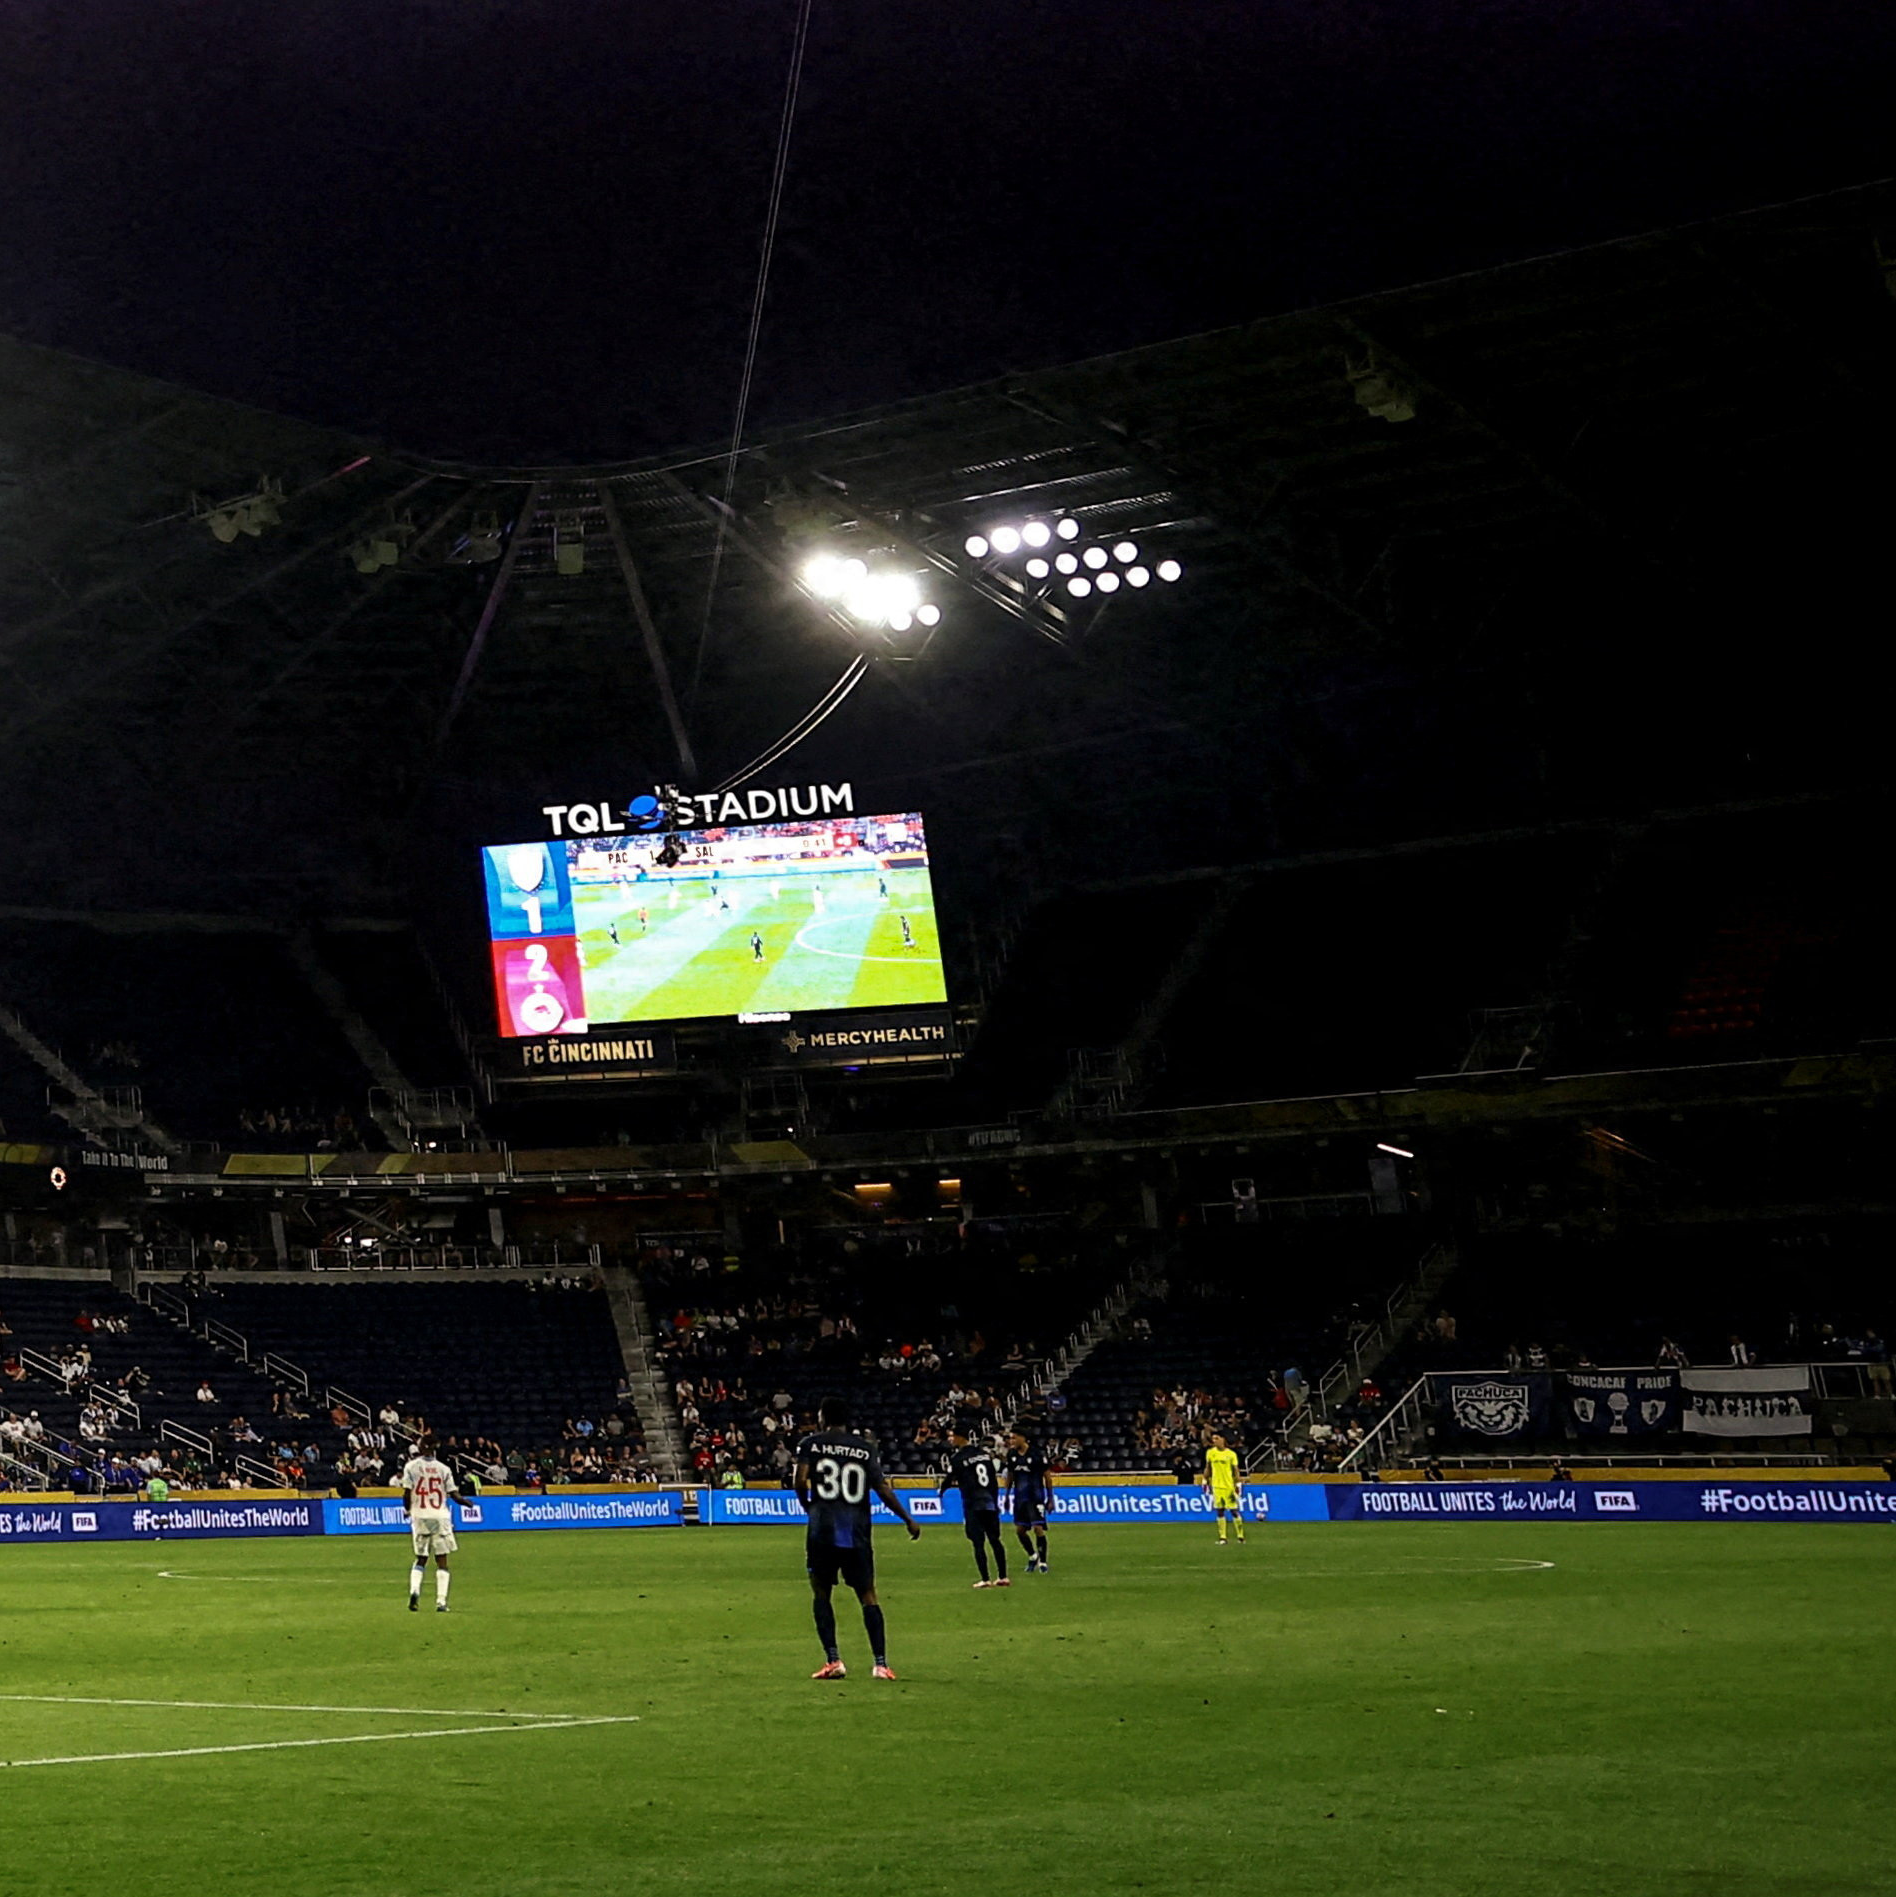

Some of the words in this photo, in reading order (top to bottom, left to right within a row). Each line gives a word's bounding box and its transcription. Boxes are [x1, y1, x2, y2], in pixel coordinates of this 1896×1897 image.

[543, 801, 625, 835] TQL
[677, 783, 855, 825] STADIUM
[608, 852, 628, 865] PAC
[696, 846, 714, 858] SAL
[521, 896, 542, 933] 1
[525, 945, 550, 981] 2
[811, 1026, 945, 1047] MERCYHEALTH
[523, 1045, 545, 1067] FC
[549, 1040, 654, 1064] CINCINNATI
[82, 1151, 100, 1165] Take
[120, 1153, 134, 1167] The
[138, 1155, 168, 1170] World
[1457, 1387, 1522, 1398] PACHUCA
[1636, 1375, 1672, 1389] PRIDE
[1692, 1396, 1804, 1417] PACHUCA
[816, 1458, 865, 1504] 30
[975, 1464, 989, 1487] 8
[415, 1476, 442, 1509] 45
[1362, 1491, 1438, 1513] FOOTBALL
[1441, 1490, 1495, 1512] UNITES
[1499, 1491, 1528, 1510] the
[1529, 1489, 1577, 1513] World
[1602, 1496, 1630, 1507] FIFA
[339, 1506, 381, 1526] FOOTBALL
[464, 1509, 478, 1518] FIFA
[511, 1500, 670, 1522] #FootballUnitesTheWorld
[725, 1497, 786, 1516] FOOTBALL
[914, 1502, 937, 1511] FIFA
[14, 1511, 32, 1533] the
[32, 1510, 61, 1534] World
[75, 1517, 93, 1527] FIFA
[132, 1507, 309, 1532] #FootballUnitesTheWorld
